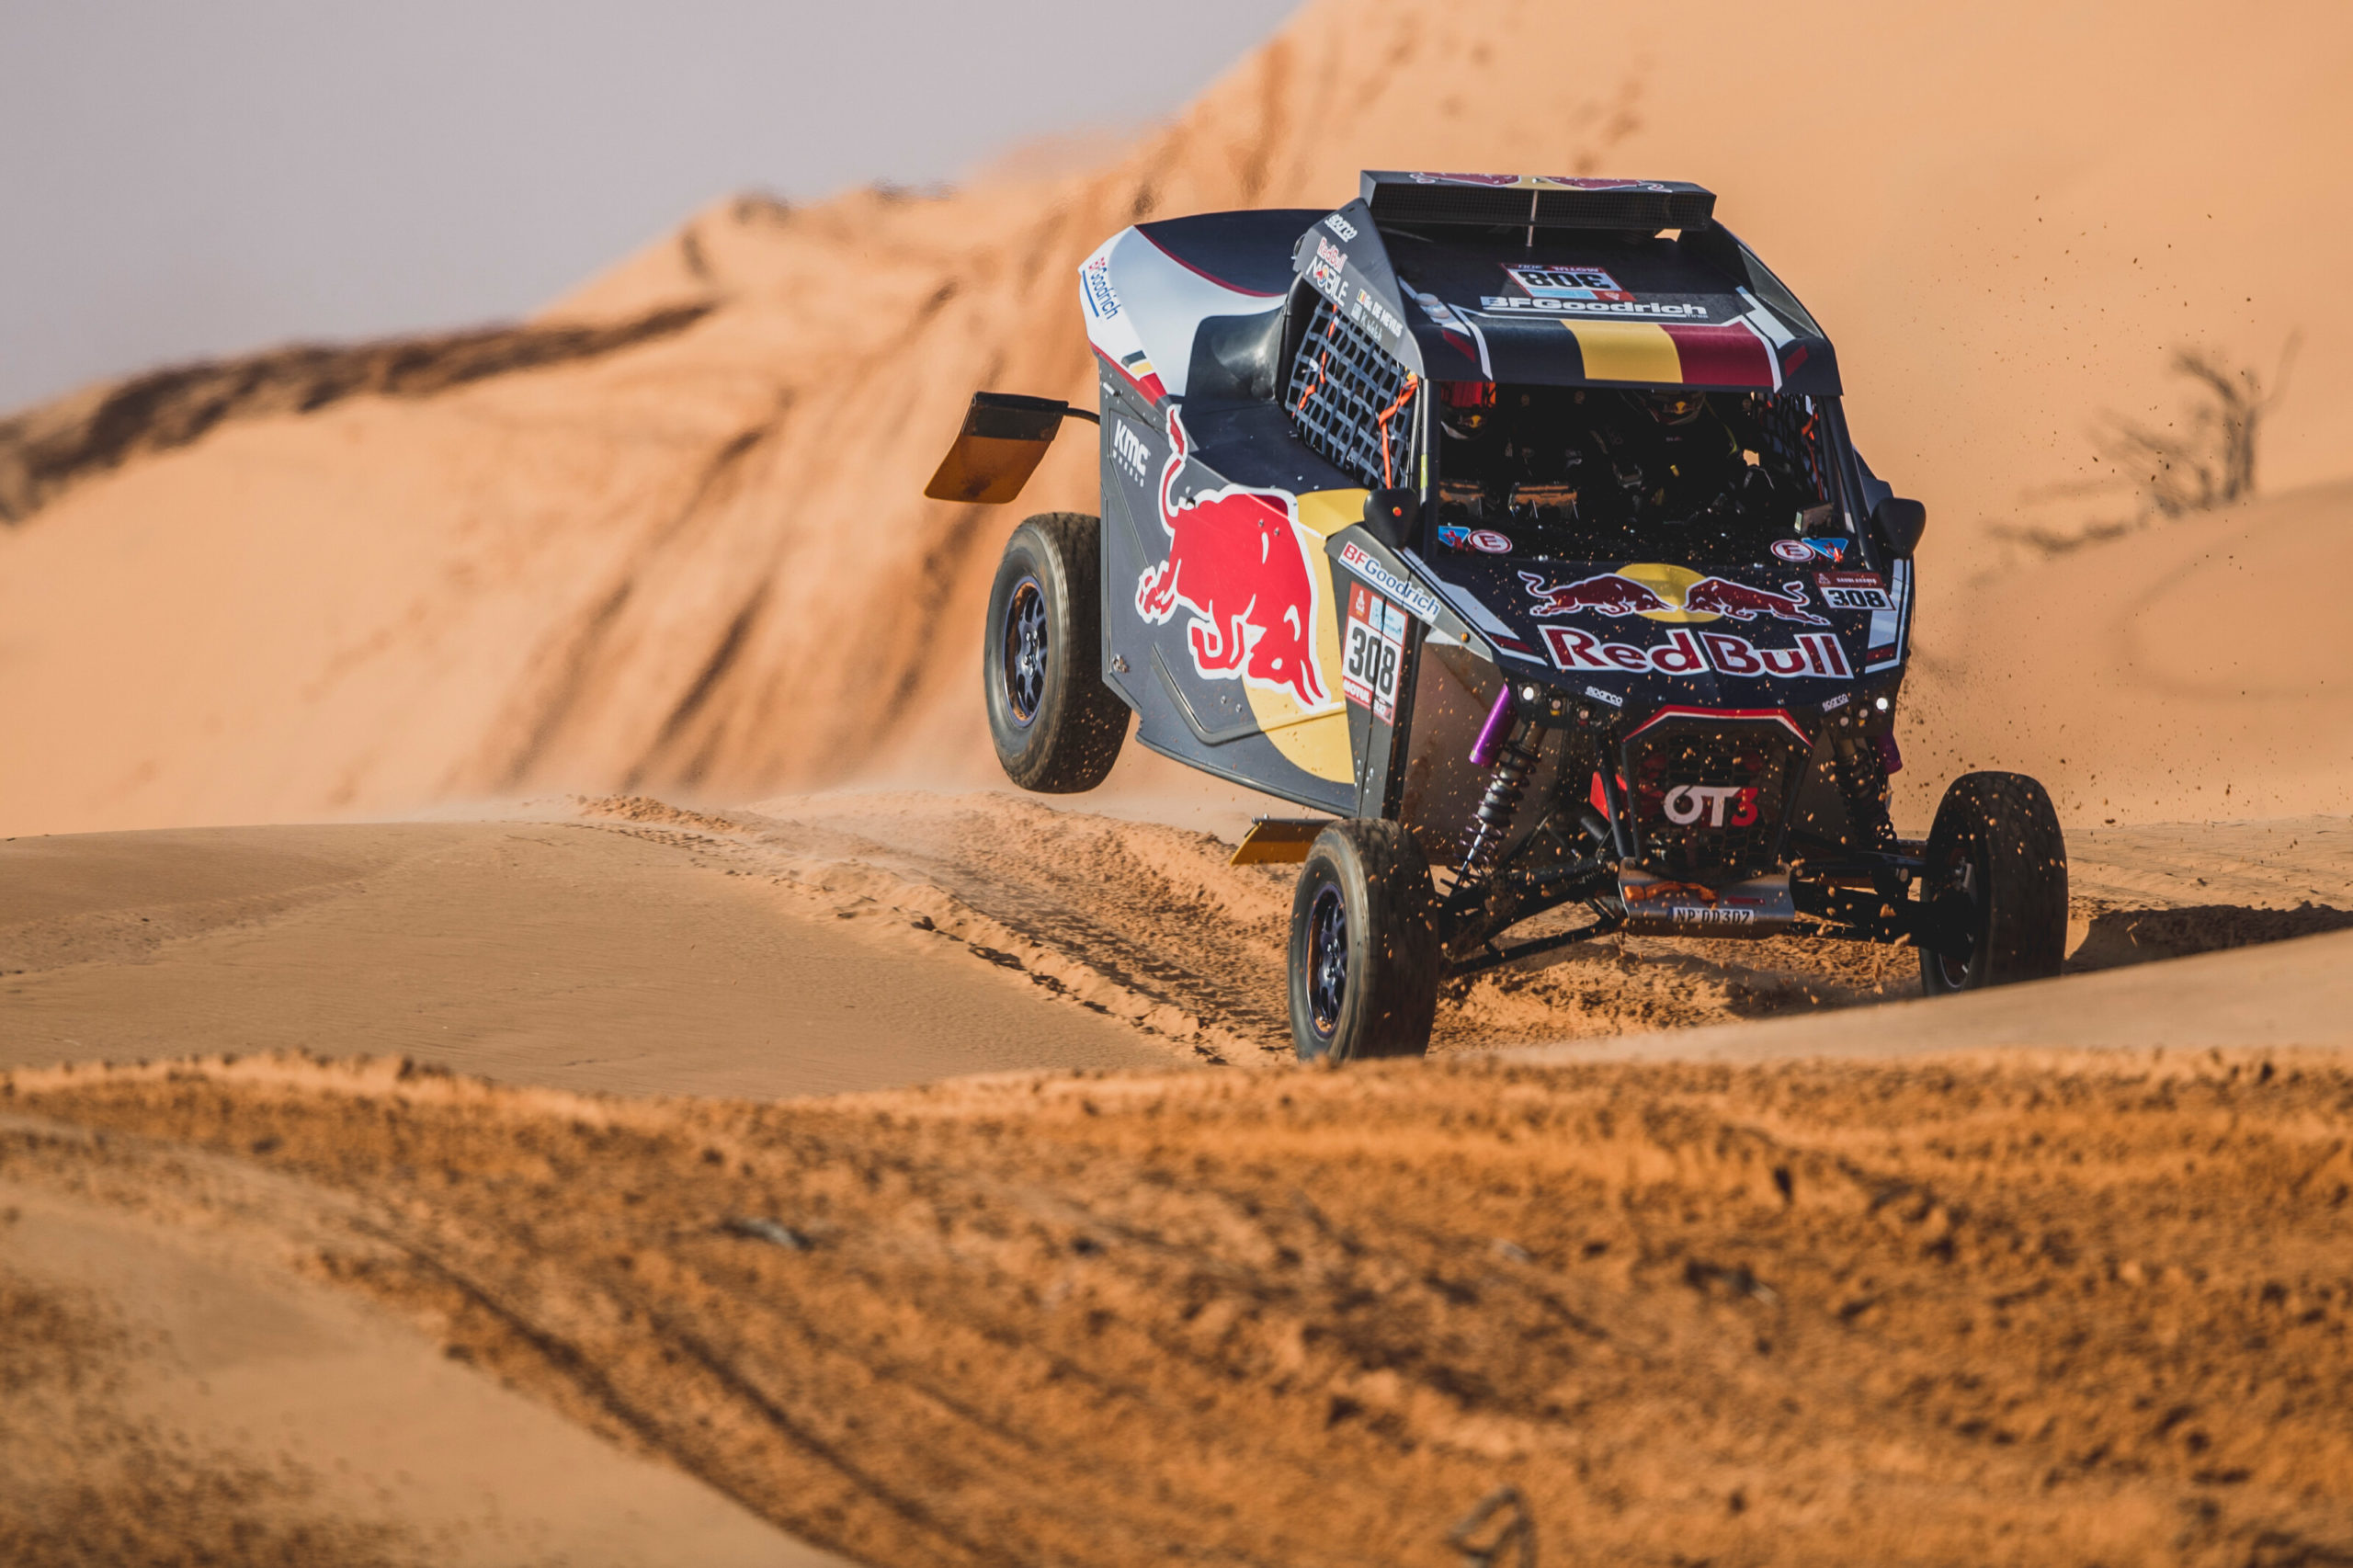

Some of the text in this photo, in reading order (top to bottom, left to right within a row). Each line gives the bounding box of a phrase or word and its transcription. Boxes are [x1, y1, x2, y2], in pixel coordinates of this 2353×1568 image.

[1324, 213, 1358, 243] sparco
[1317, 236, 1348, 274] Red Bull
[1305, 256, 1349, 308] MOBILE
[1518, 271, 1611, 289] 308
[1481, 296, 1708, 314] BFGoodrich
[1114, 418, 1149, 477] KMC
[1479, 535, 1501, 548] E
[1782, 545, 1804, 557] E
[1343, 543, 1440, 616] BFGoodrich
[1828, 589, 1885, 608] 308
[1348, 626, 1396, 697] 308
[1539, 625, 1853, 678] Red Bull
[1585, 686, 1623, 708] sparco
